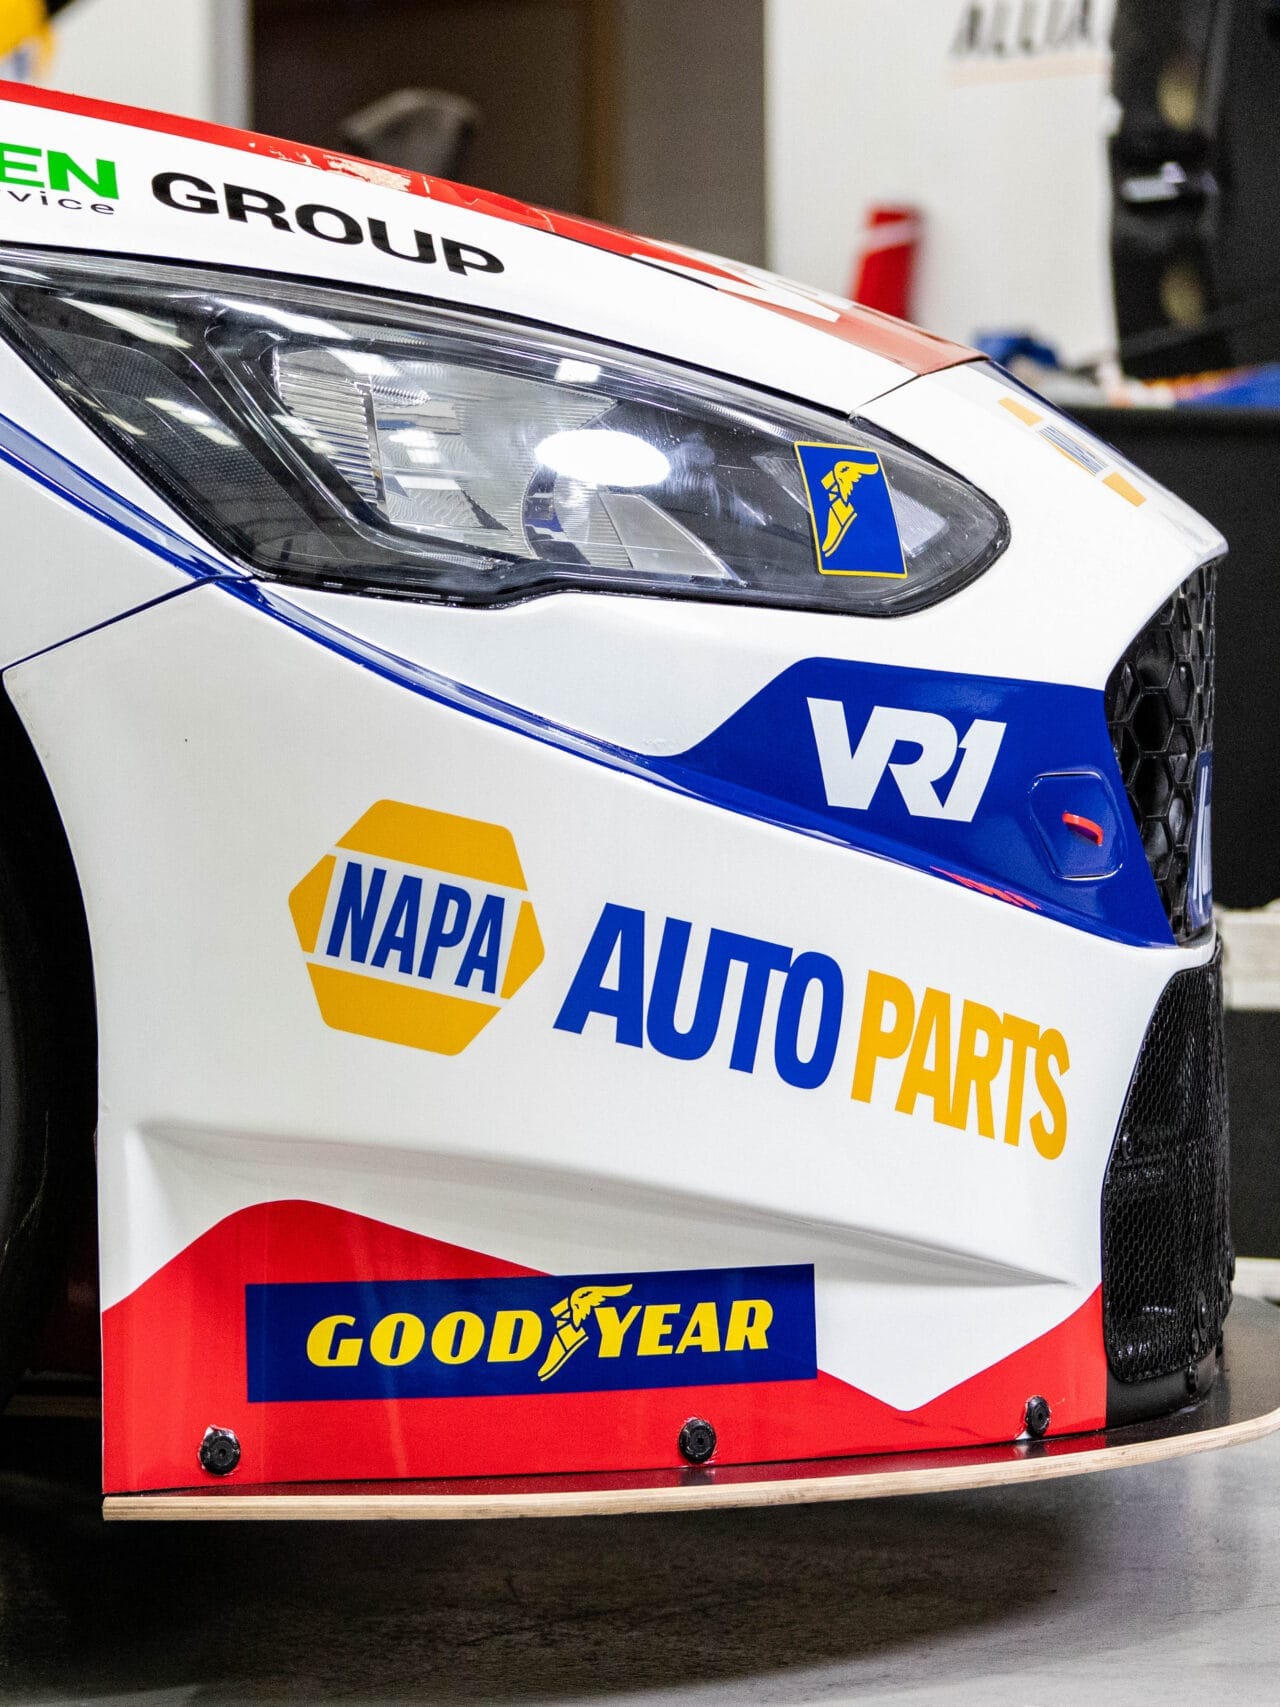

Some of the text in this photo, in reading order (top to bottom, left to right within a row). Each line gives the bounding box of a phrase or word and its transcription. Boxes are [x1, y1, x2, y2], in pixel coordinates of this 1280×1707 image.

[151, 171, 505, 276] GROUP
[806, 697, 1007, 822] VR1
[326, 861, 505, 994] NAPA
[553, 902, 1070, 1161] AUTO PARTS
